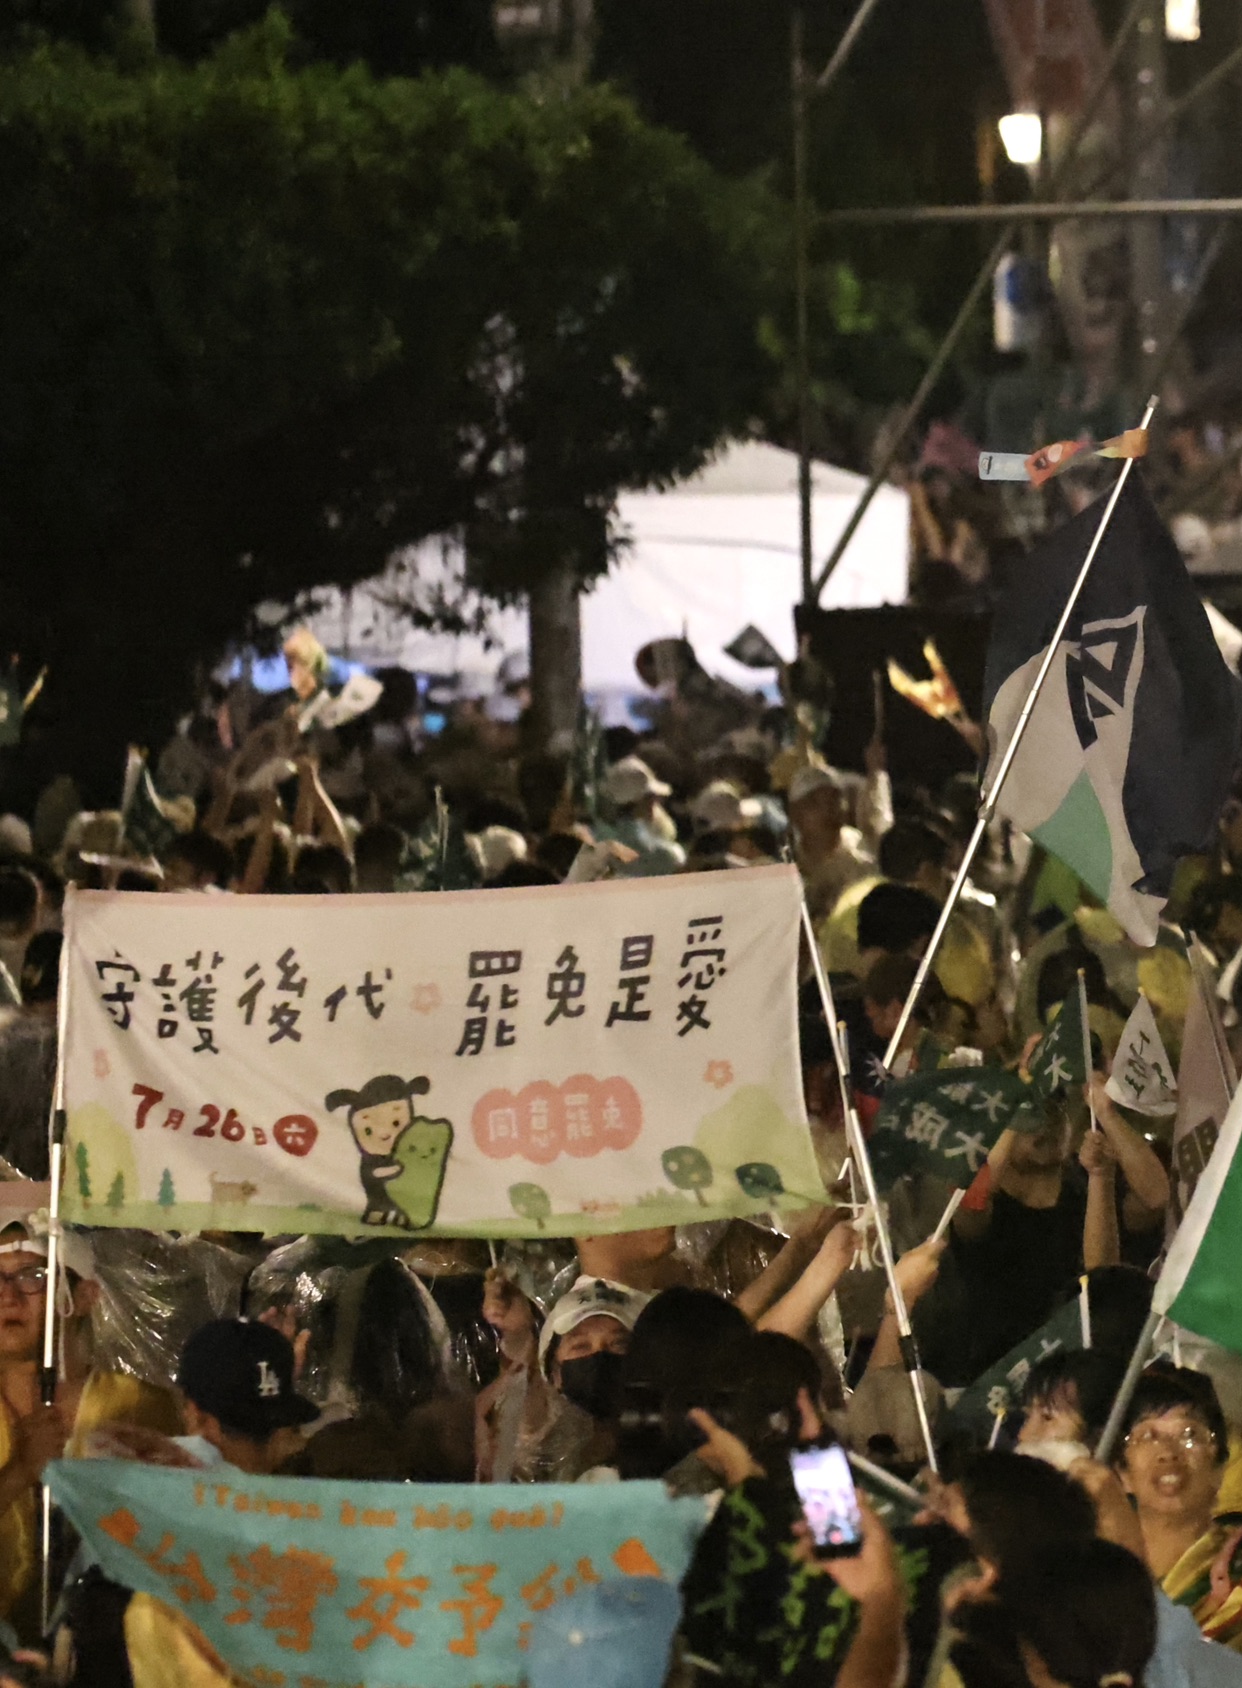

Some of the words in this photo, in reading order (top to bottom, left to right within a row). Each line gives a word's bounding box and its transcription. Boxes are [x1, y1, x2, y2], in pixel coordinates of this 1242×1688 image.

[95, 947, 392, 1055] 守護後代
[454, 915, 726, 1056] 罷免是愛
[489, 1092, 625, 1148] 同意罷免
[257, 1361, 280, 1397] LA
